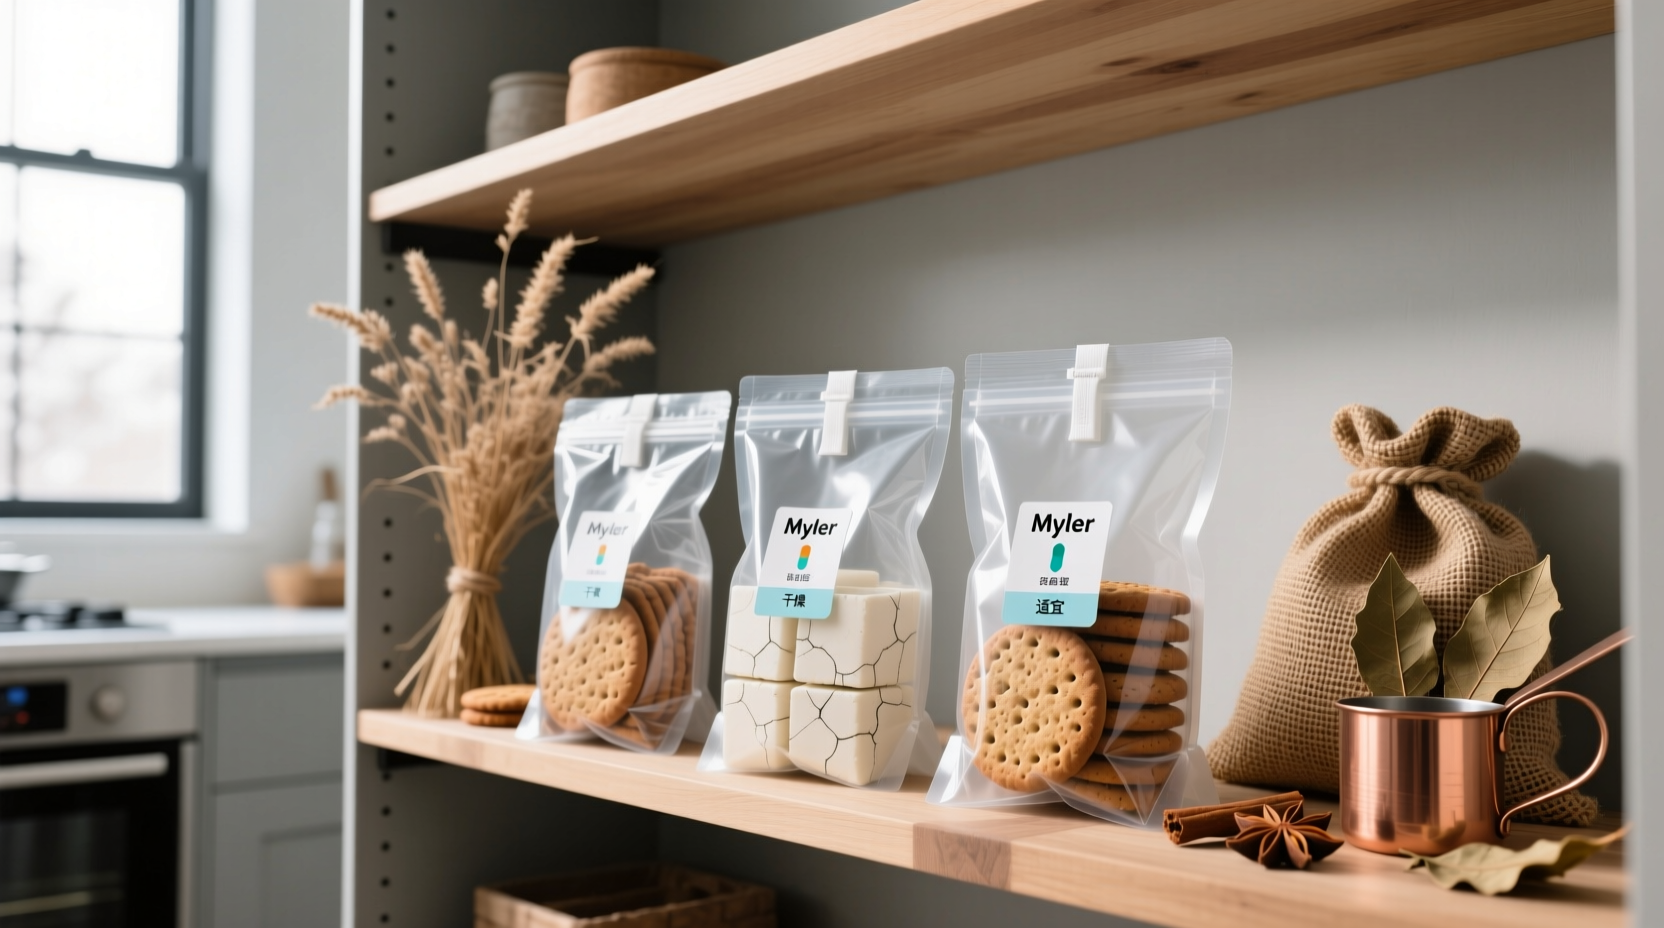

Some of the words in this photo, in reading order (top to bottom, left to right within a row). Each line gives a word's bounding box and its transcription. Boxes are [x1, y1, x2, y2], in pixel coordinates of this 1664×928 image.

[587, 521, 629, 540] Myler
[784, 517, 838, 540] Myler
[1031, 512, 1096, 539] Myler
